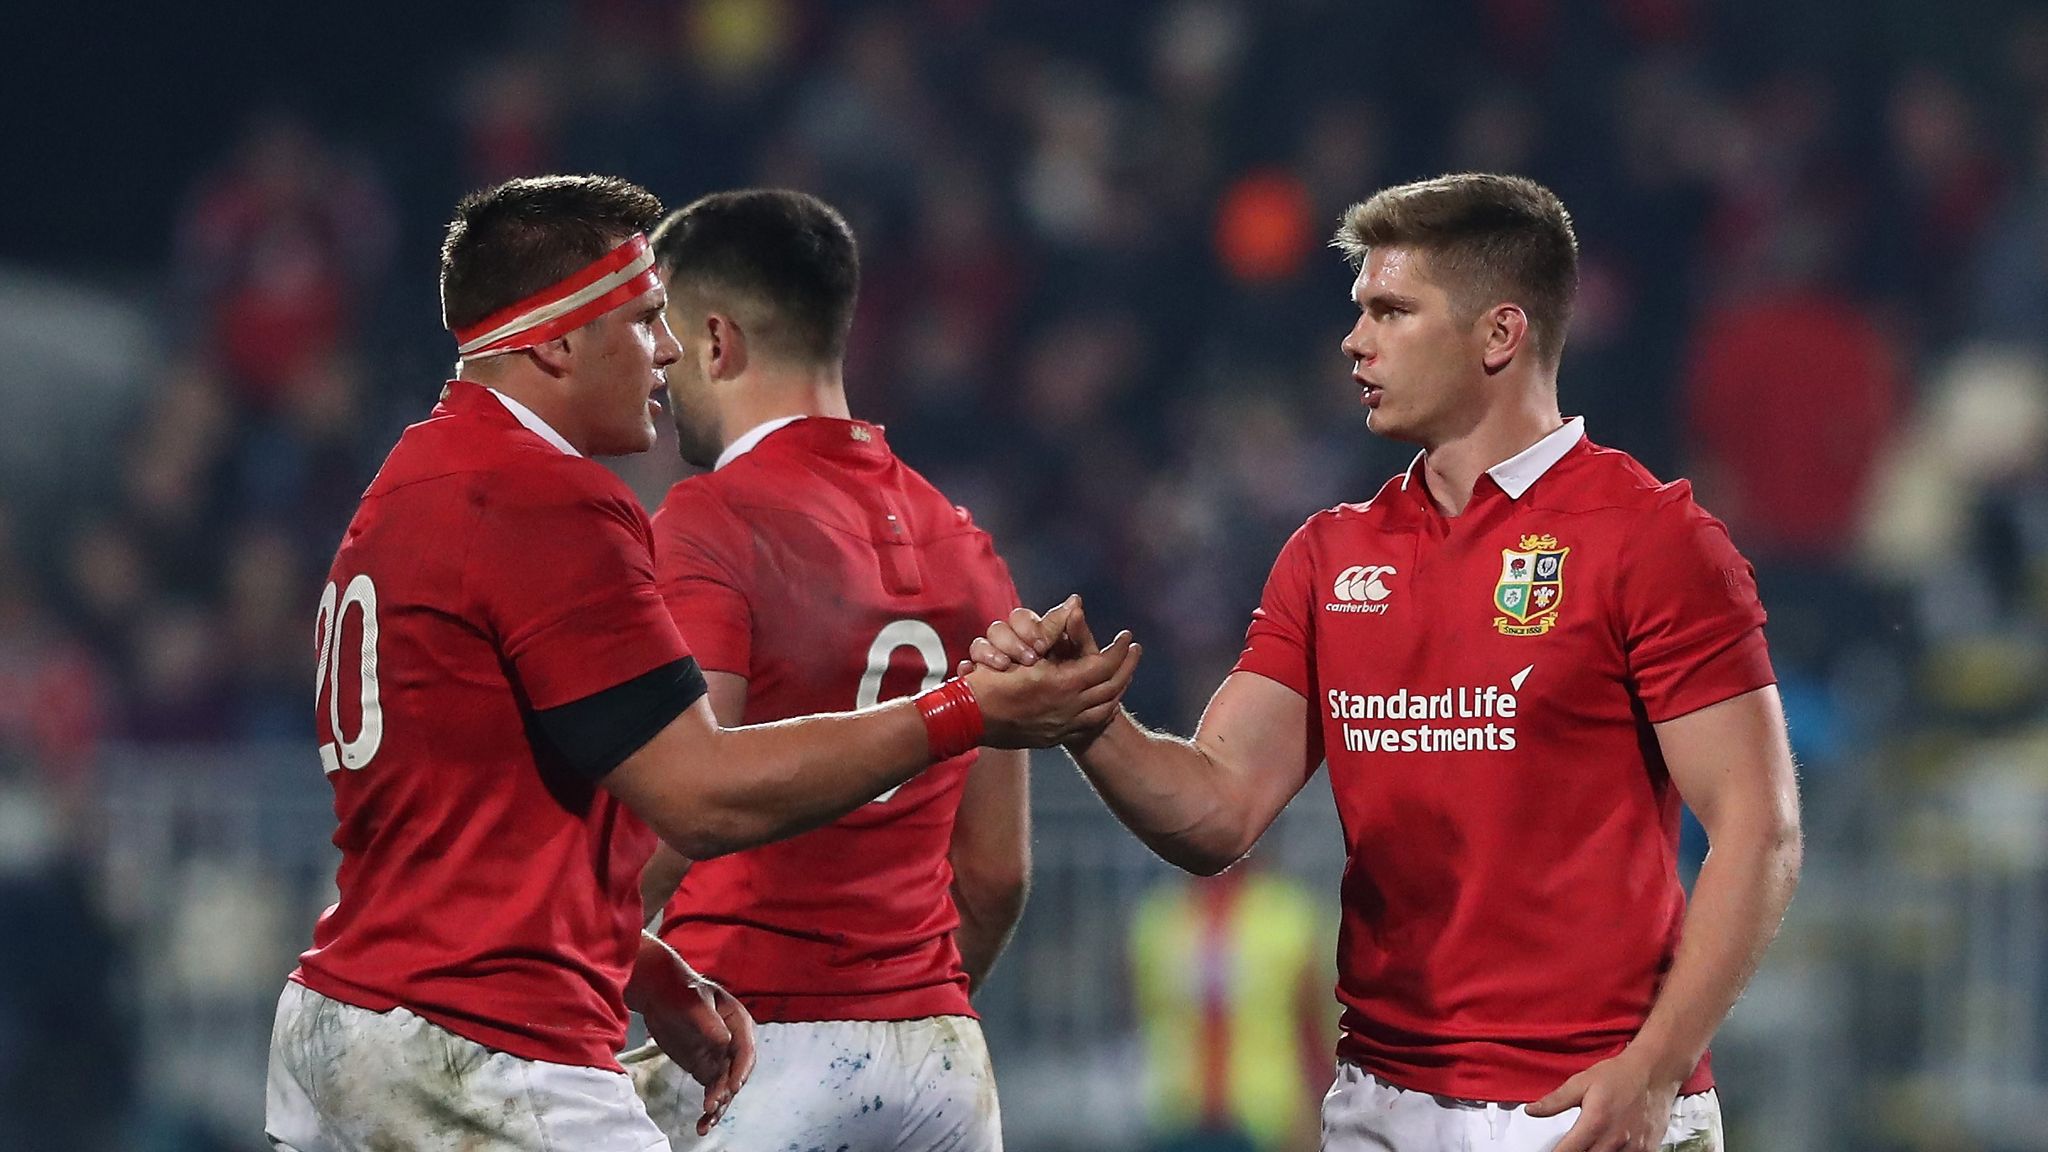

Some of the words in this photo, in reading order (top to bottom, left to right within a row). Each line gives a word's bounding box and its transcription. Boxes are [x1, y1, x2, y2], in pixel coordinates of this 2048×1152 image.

[1325, 601, 1389, 615] canterbury
[315, 574, 383, 774] 20
[1328, 688, 1453, 720] Standard
[1459, 687, 1516, 718] Life
[1343, 723, 1517, 752] Investments
